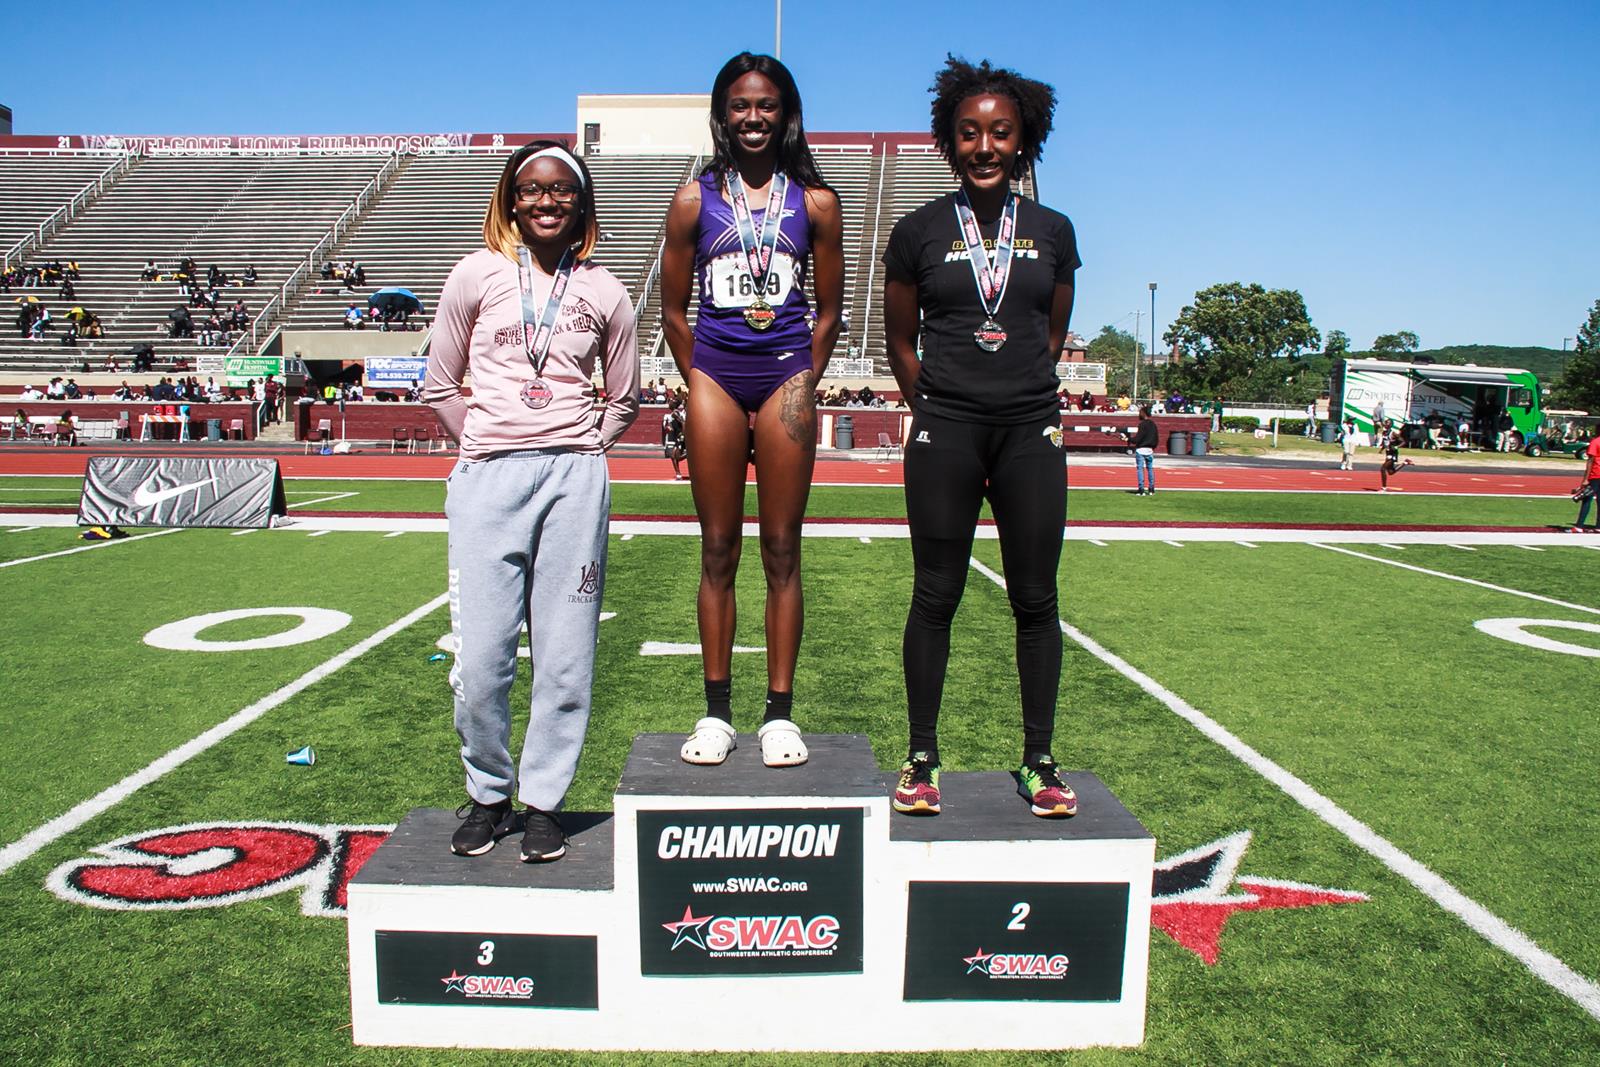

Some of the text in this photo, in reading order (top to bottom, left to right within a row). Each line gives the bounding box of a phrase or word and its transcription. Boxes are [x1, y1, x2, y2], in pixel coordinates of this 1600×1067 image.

[58, 136, 71, 148] 21
[123, 137, 232, 156] WELCOME
[238, 137, 300, 156] HOME
[492, 134, 504, 147] 23
[944, 248, 1039, 263] HONTS
[725, 272, 781, 297] 169
[1364, 389, 1402, 401] SPORTS
[657, 824, 840, 859] CHAMPION
[1007, 902, 1031, 930] 2
[705, 915, 840, 951] SWAC
[477, 940, 495, 965] 3
[988, 954, 1069, 975] SWAC
[463, 975, 534, 995] SWAC
